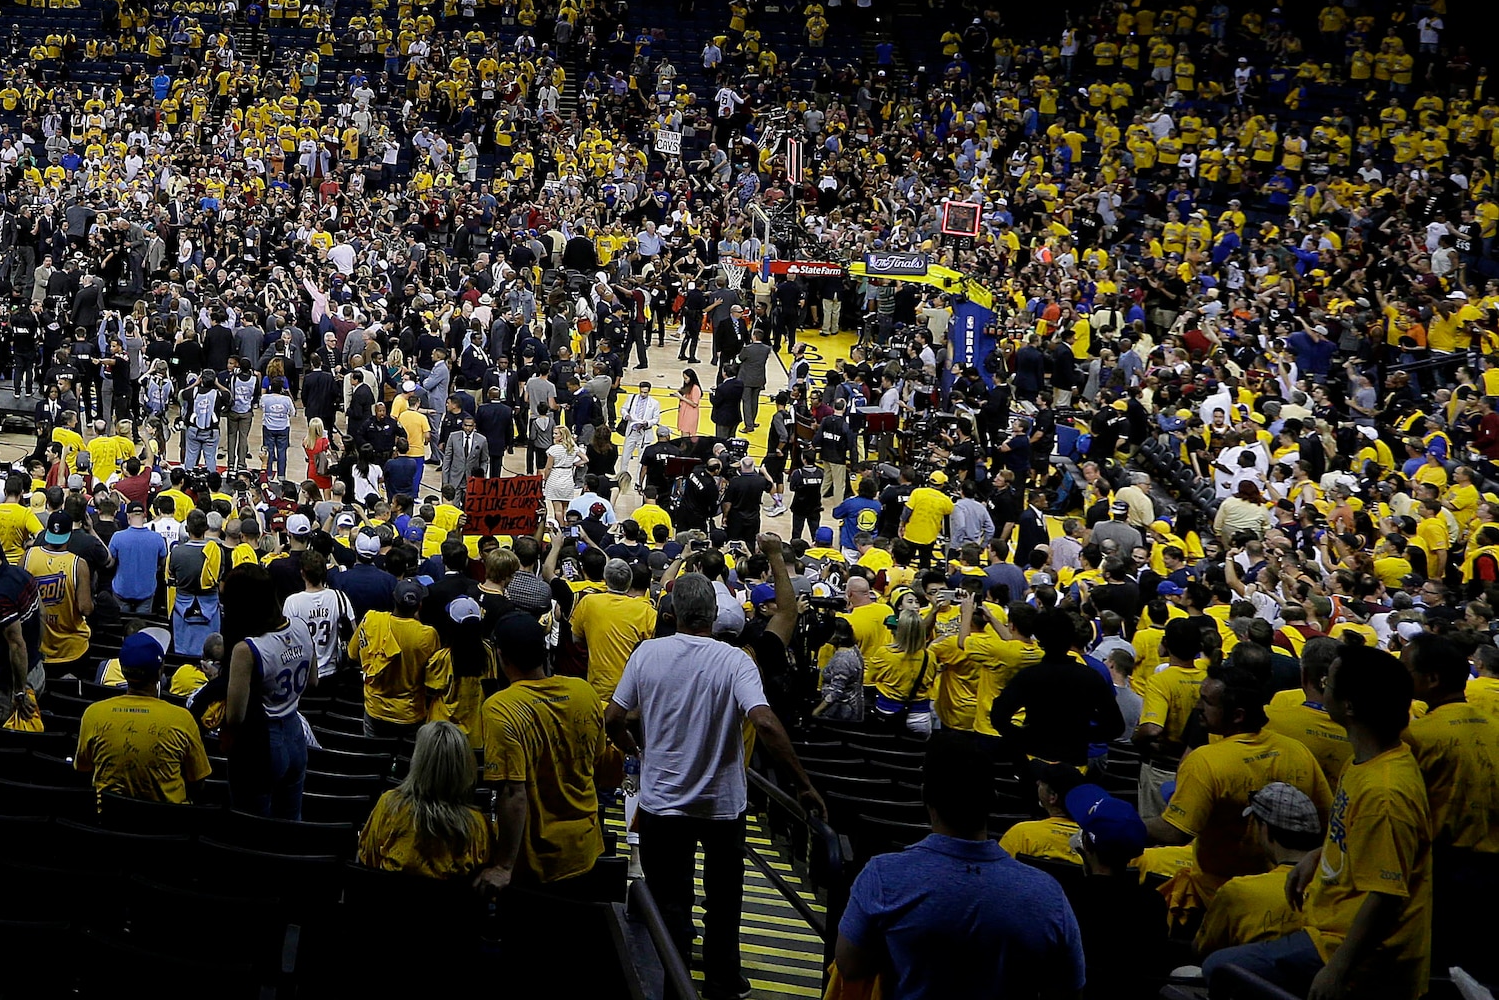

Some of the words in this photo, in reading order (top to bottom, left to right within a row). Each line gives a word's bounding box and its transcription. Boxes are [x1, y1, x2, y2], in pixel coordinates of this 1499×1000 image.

[657, 139, 678, 152] CAVS
[888, 254, 925, 269] Finals
[468, 479, 476, 495] 1
[466, 498, 475, 512] 2
[477, 498, 484, 512] I
[485, 497, 508, 511] LIKE
[474, 516, 482, 531] I
[516, 515, 537, 529] CAV
[39, 582, 56, 600] 30
[309, 608, 329, 619] JAMES
[280, 645, 303, 665] CURRY
[273, 660, 310, 701] 30
